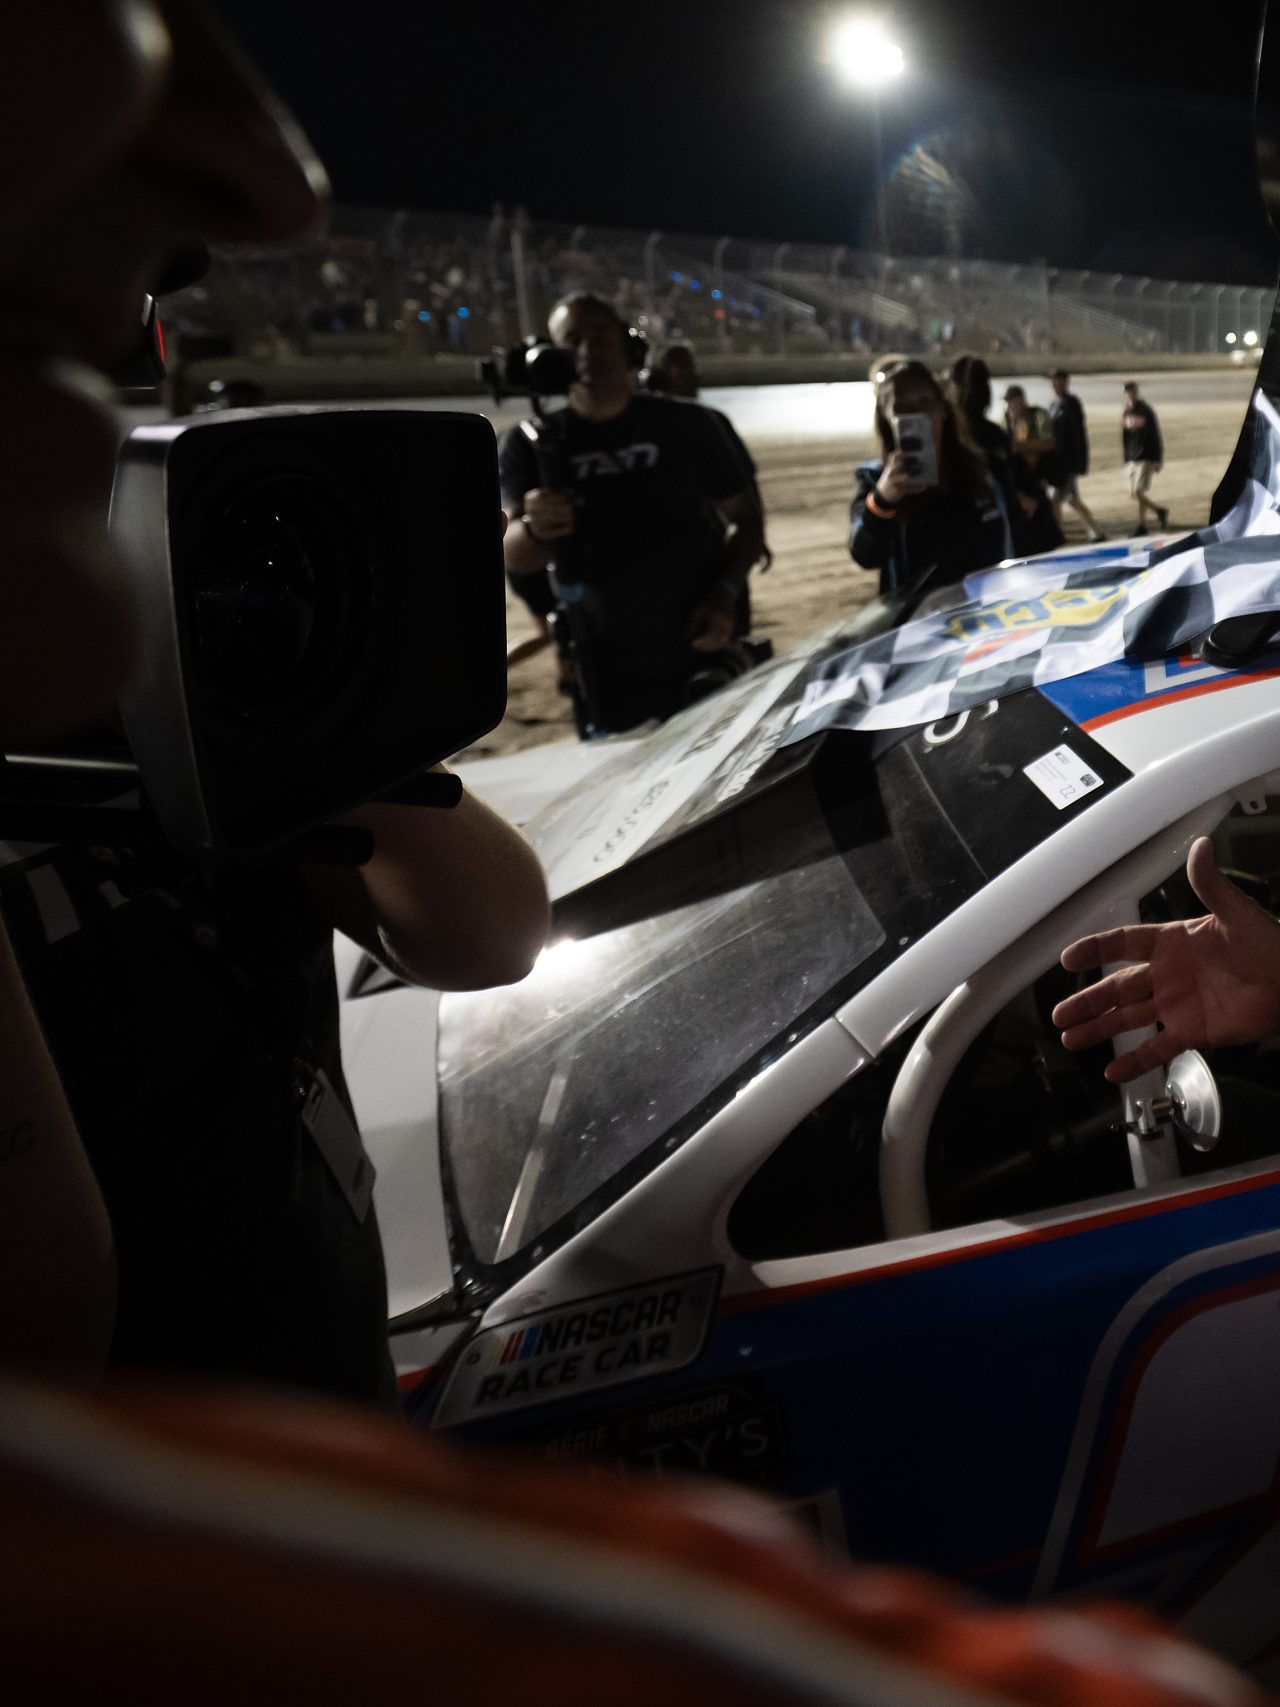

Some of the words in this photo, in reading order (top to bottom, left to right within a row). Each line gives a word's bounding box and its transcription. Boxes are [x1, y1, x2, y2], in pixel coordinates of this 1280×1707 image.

[535, 1290, 682, 1356] NASCAR
[476, 1354, 583, 1405] RACE
[595, 1332, 671, 1374] CAR
